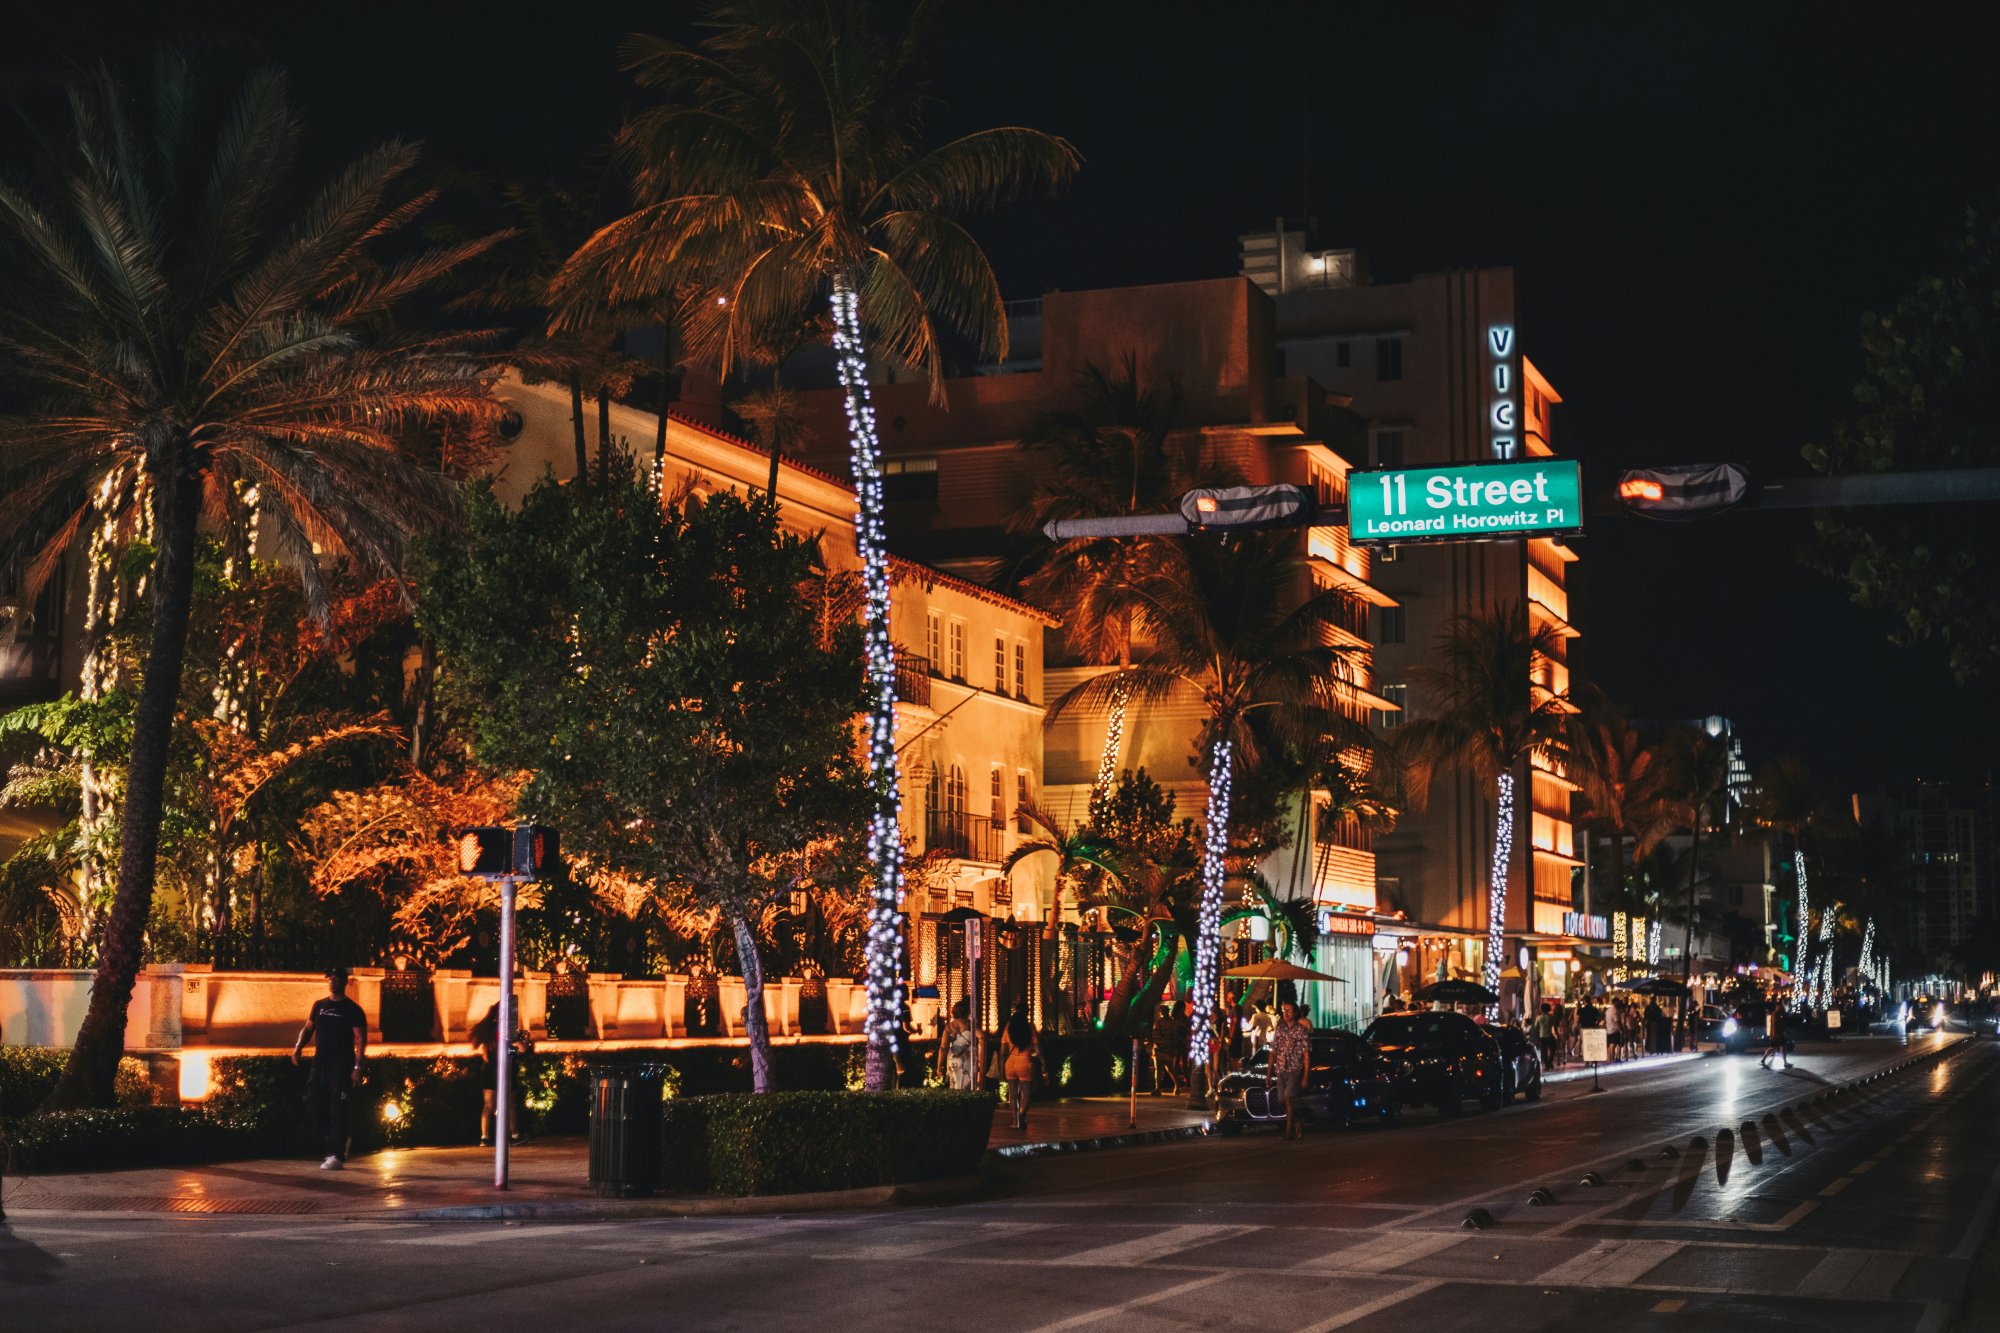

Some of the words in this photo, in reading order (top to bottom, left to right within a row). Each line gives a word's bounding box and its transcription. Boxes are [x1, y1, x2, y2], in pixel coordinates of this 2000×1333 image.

[1380, 475, 1407, 515] 11
[1426, 472, 1549, 508] Street
[1368, 515, 1445, 533] Leonard
[1453, 511, 1538, 528] Horowitz
[1547, 508, 1563, 523] Pl
